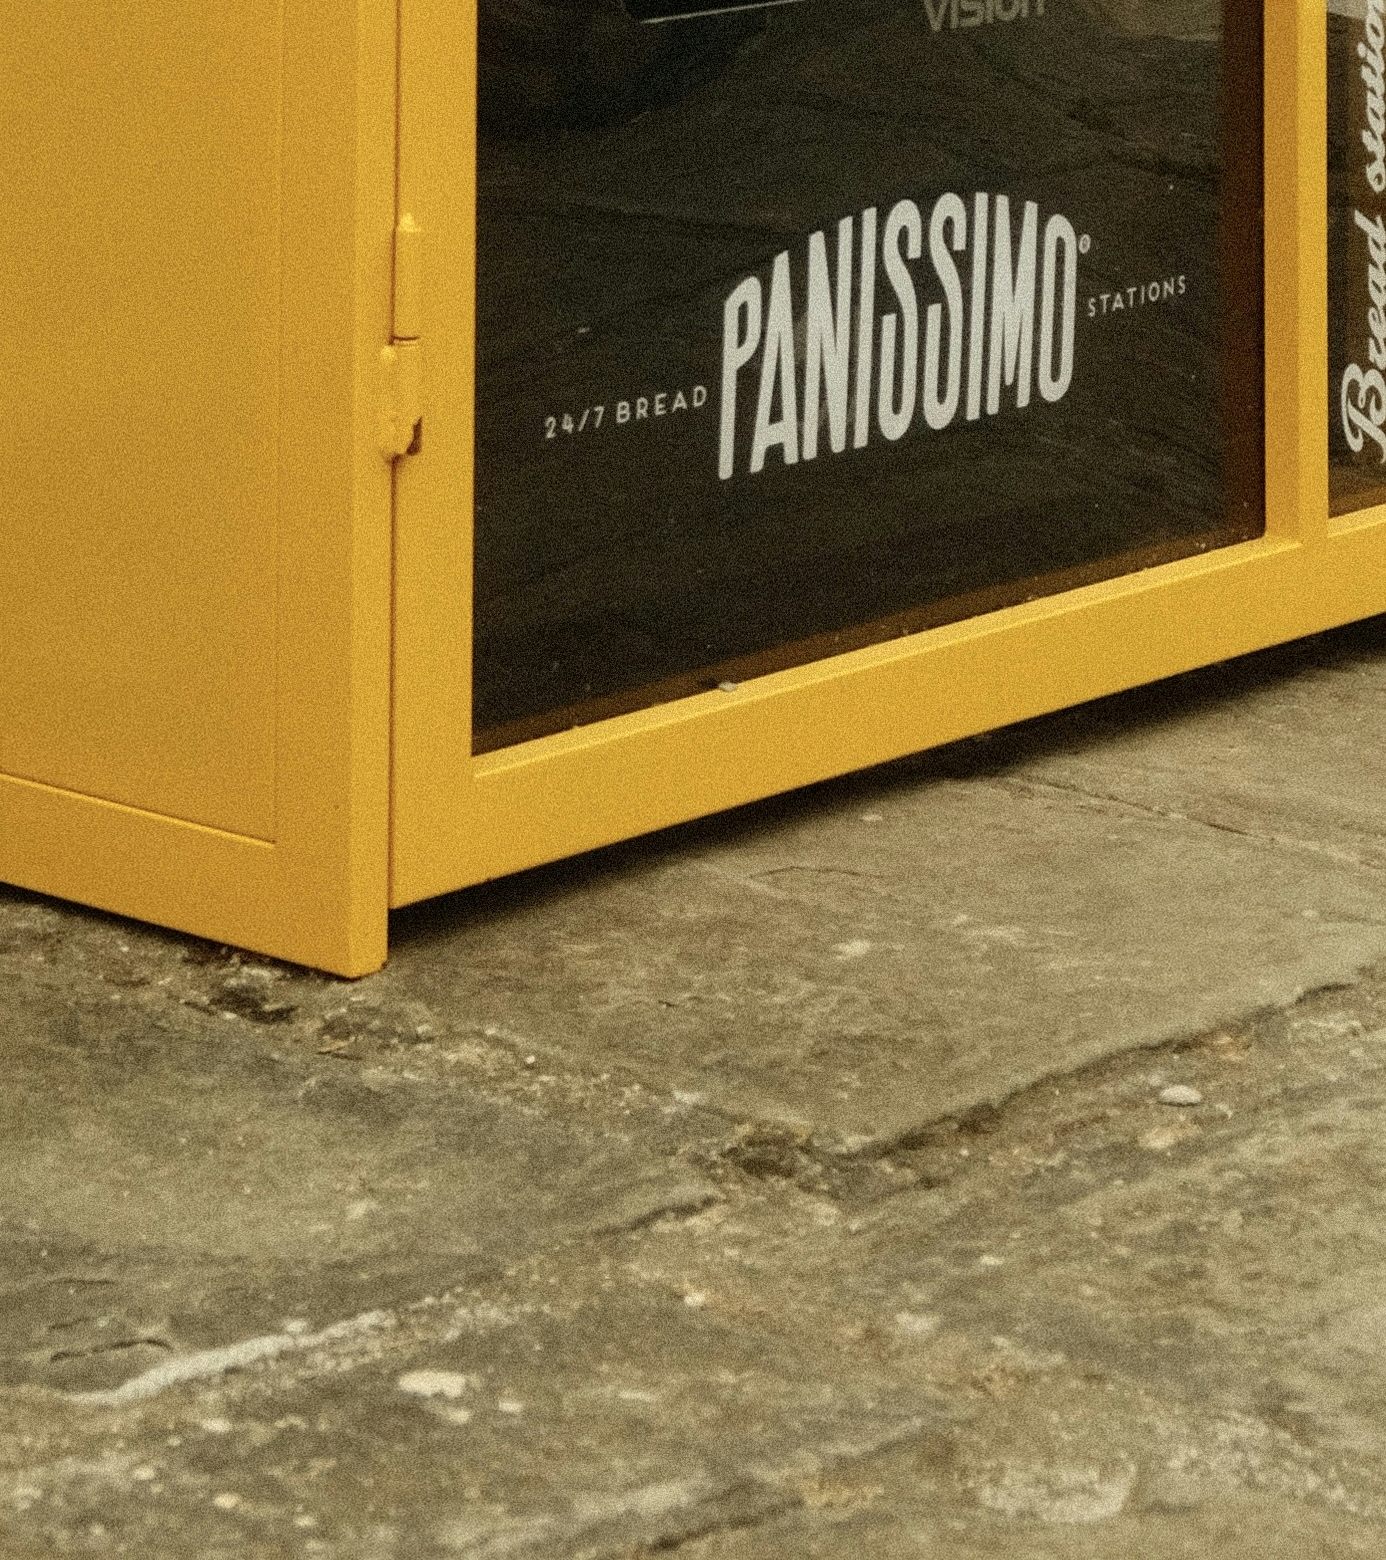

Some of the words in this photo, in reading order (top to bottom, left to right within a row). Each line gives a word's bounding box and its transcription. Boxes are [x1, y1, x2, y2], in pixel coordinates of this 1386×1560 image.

[544, 405, 605, 440] 24/7
[615, 385, 710, 425] BREAD
[1087, 274, 1187, 318] STATIONS
